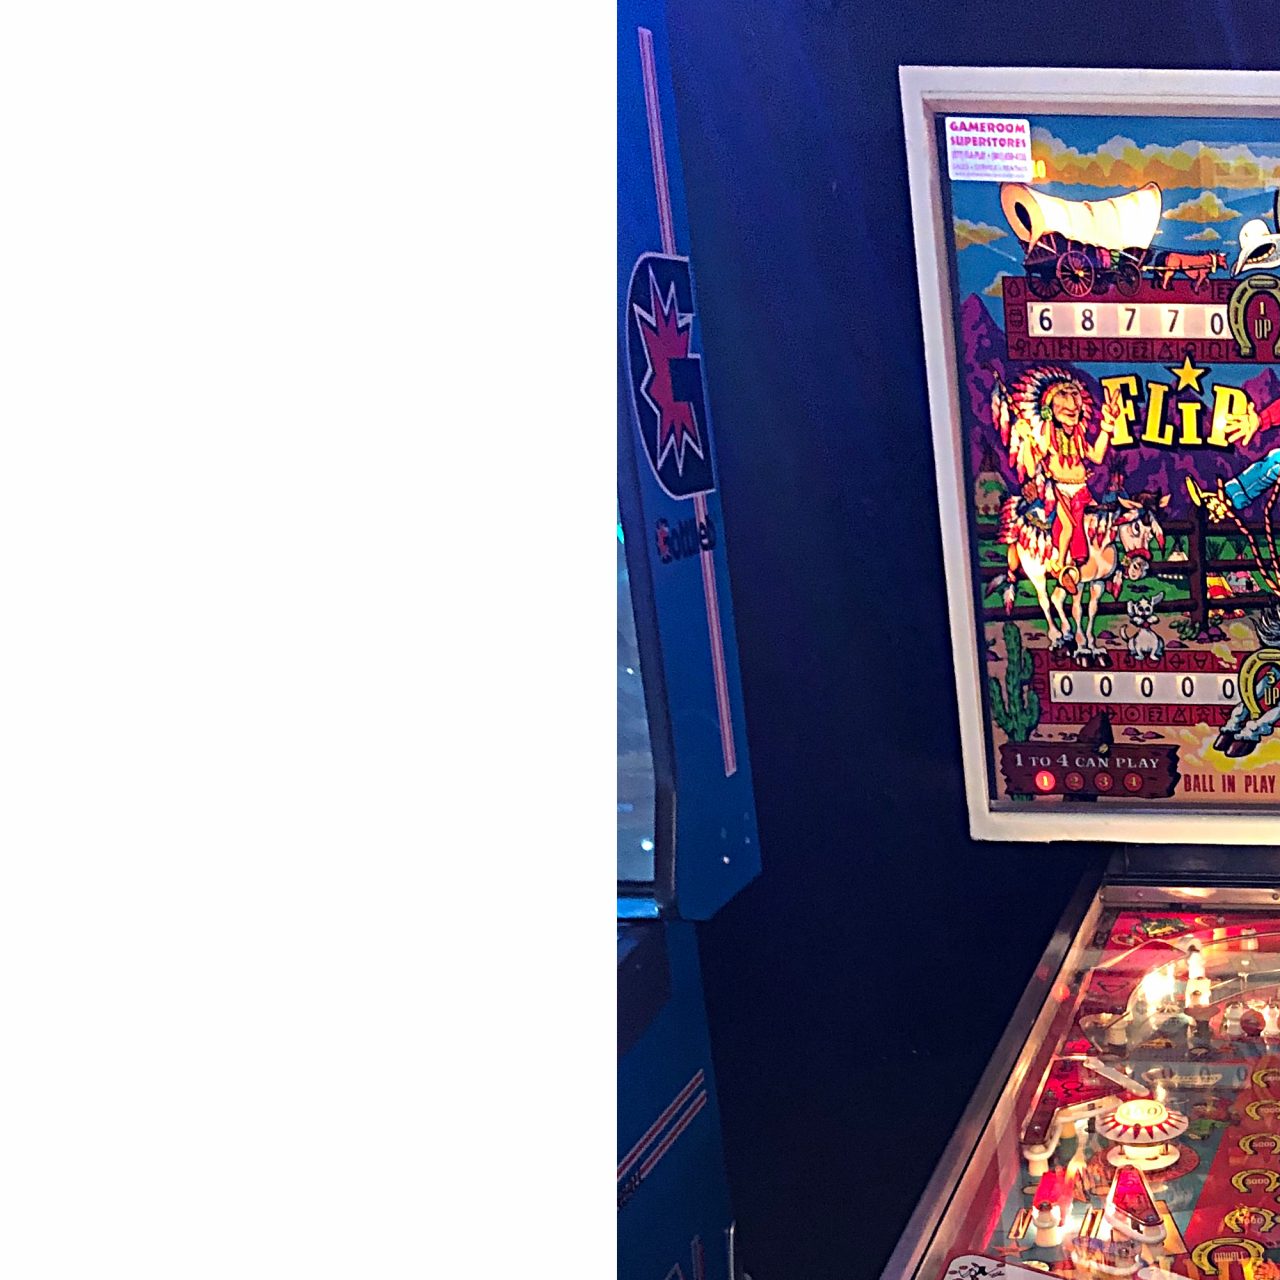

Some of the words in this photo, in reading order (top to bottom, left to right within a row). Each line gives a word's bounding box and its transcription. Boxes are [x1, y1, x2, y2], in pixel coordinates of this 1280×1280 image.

[949, 121, 1026, 134] GAMEROOM
[950, 135, 1027, 148] SUPERSTORES
[1258, 301, 1265, 316] 1
[1254, 319, 1273, 339] UP
[1267, 671, 1276, 685] 3
[1264, 686, 1280, 705] UP
[1015, 753, 1024, 767] 1
[1029, 757, 1051, 767] TO
[1056, 753, 1069, 768] 4
[1075, 757, 1110, 769] CAN
[1116, 757, 1160, 769] PLAY
[1042, 775, 1049, 786] 1
[1071, 776, 1080, 787] 2
[1099, 776, 1108, 787] 3
[1129, 776, 1138, 787] 4
[1183, 774, 1215, 793] BALL
[1222, 774, 1237, 794] IN
[1244, 774, 1277, 794] PLAY
